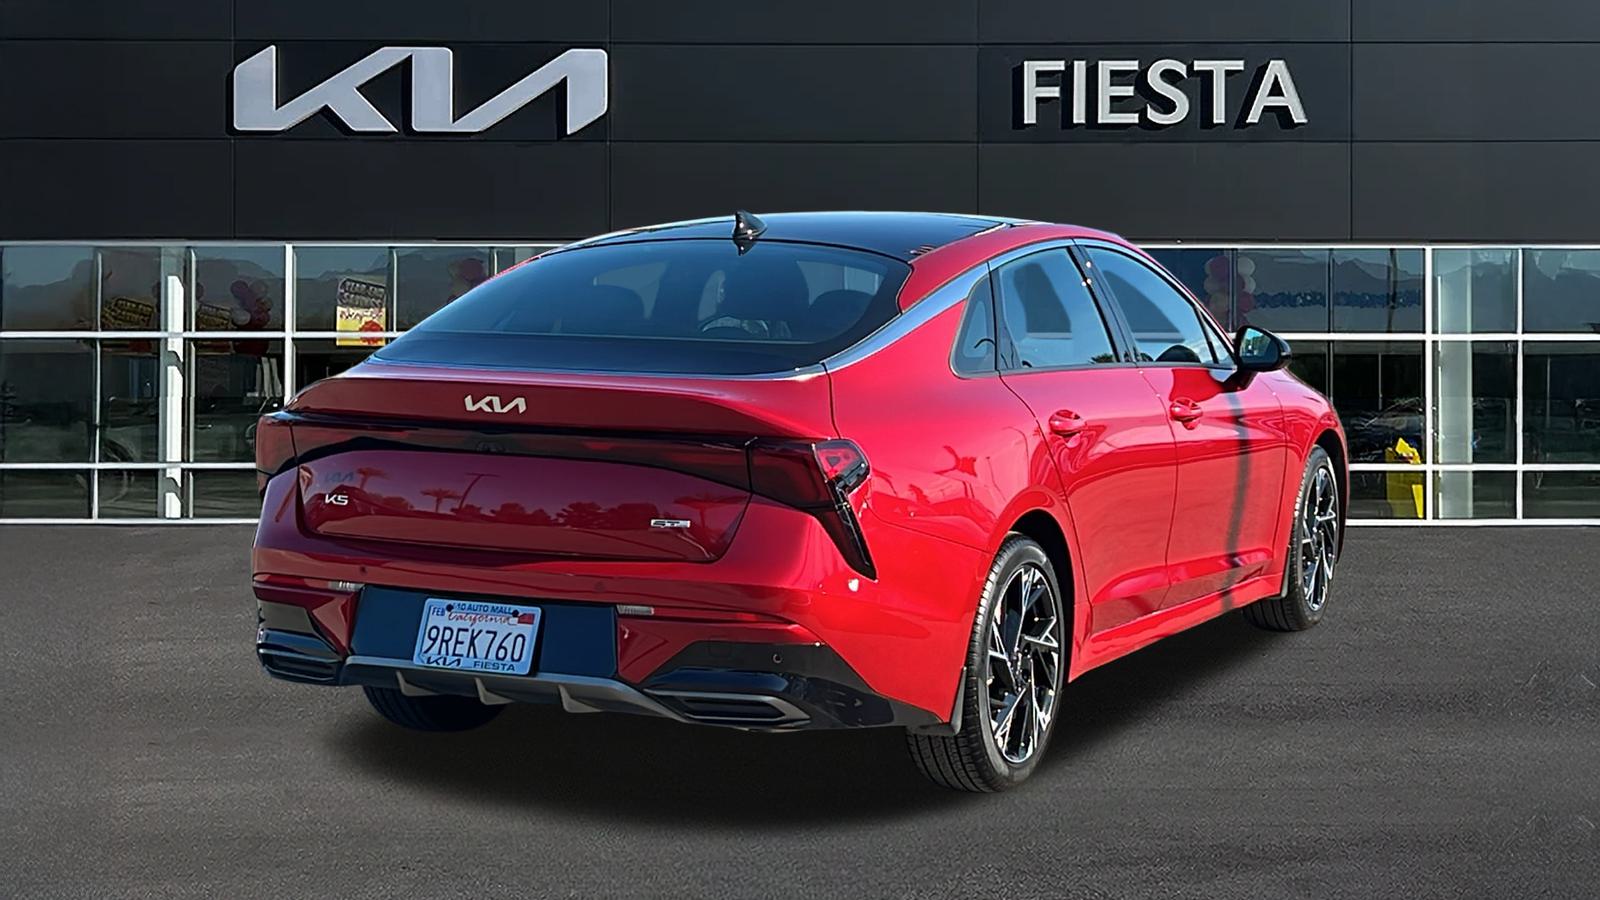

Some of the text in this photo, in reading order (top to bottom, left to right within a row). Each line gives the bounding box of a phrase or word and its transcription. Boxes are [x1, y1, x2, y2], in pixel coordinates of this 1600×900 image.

[233, 45, 608, 135] KIA
[1023, 59, 1308, 125] FIESTA
[464, 394, 527, 414] KIA
[325, 493, 349, 506] K5
[467, 603, 489, 613] AUTO
[490, 605, 513, 615] MALL
[423, 625, 526, 663] 9REK760
[426, 656, 515, 672] KIA FIESTA
